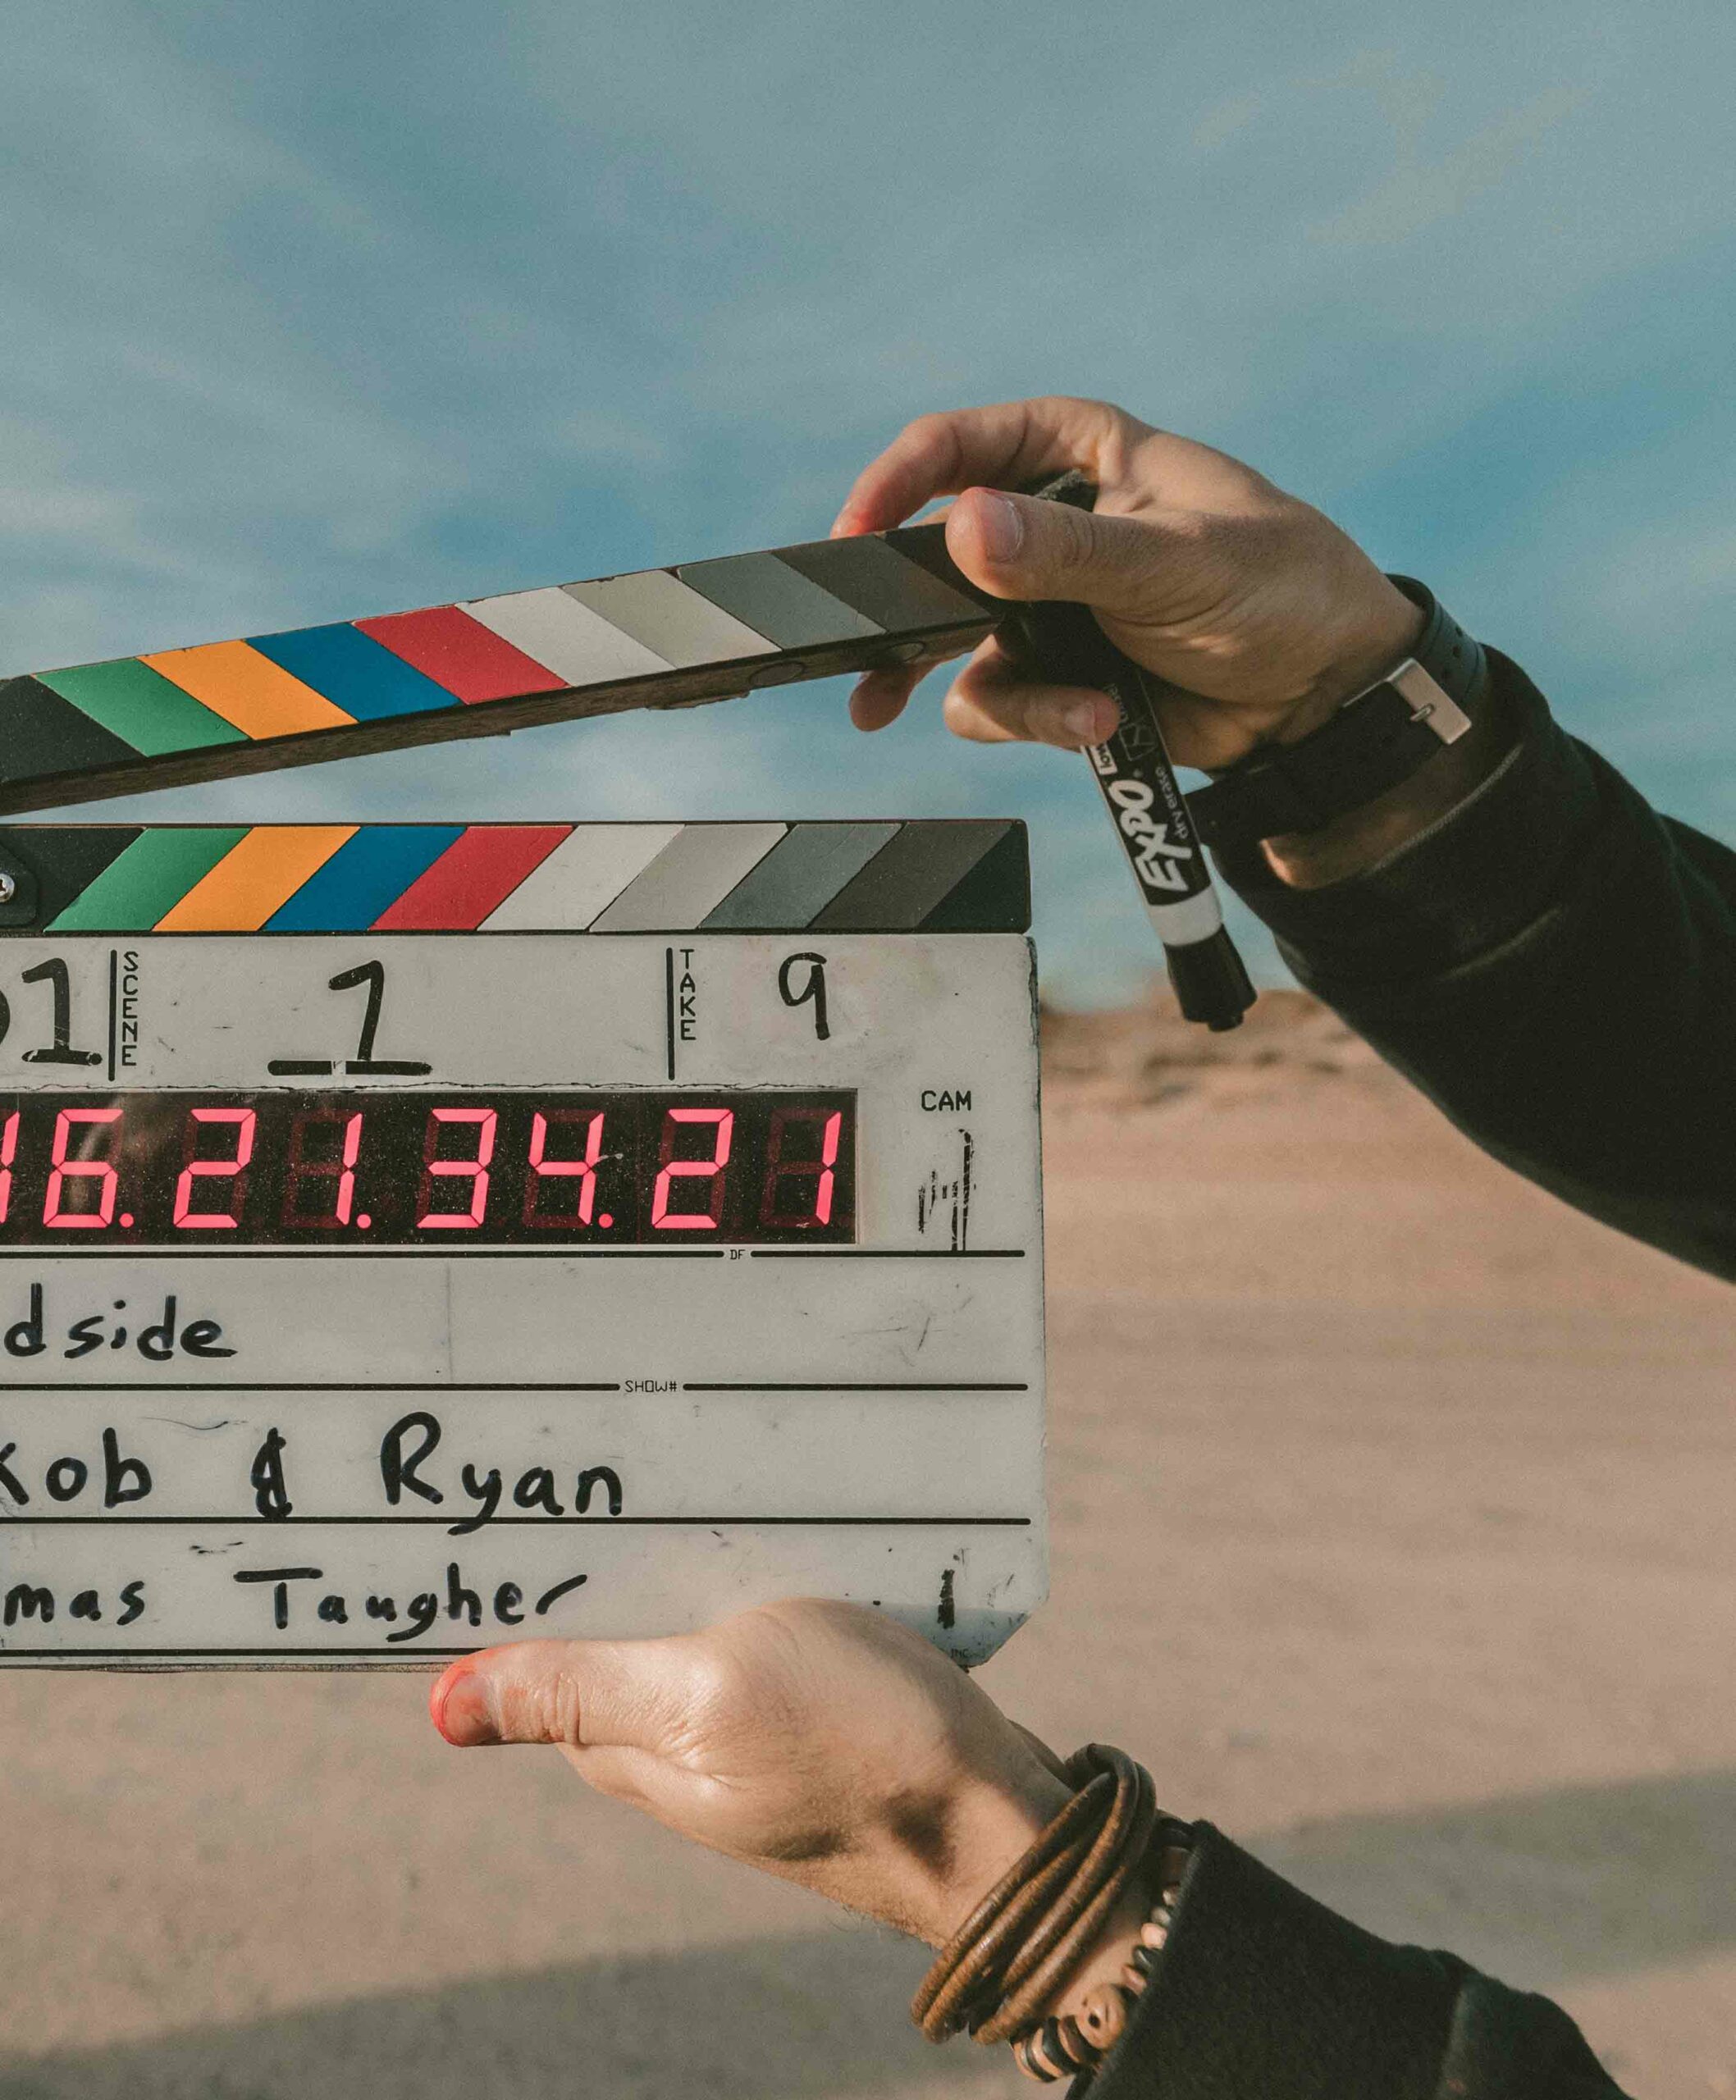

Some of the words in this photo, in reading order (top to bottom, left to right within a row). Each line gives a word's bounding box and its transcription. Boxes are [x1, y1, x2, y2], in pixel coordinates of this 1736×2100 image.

[1155, 766, 1177, 810] erase
[1172, 810, 1189, 839] dry
[1109, 780, 1192, 892] EXPO
[121, 951, 139, 1066] SCENE
[679, 948, 697, 1041] TAKE
[779, 952, 831, 1041] 9
[921, 1089, 971, 1112] CAM
[729, 1249, 746, 1260] DF
[624, 1380, 678, 1393] SHOW#
[380, 1411, 623, 1536] Ryan
[3, 1581, 145, 1627] mas
[234, 1562, 587, 1643] Taugher
